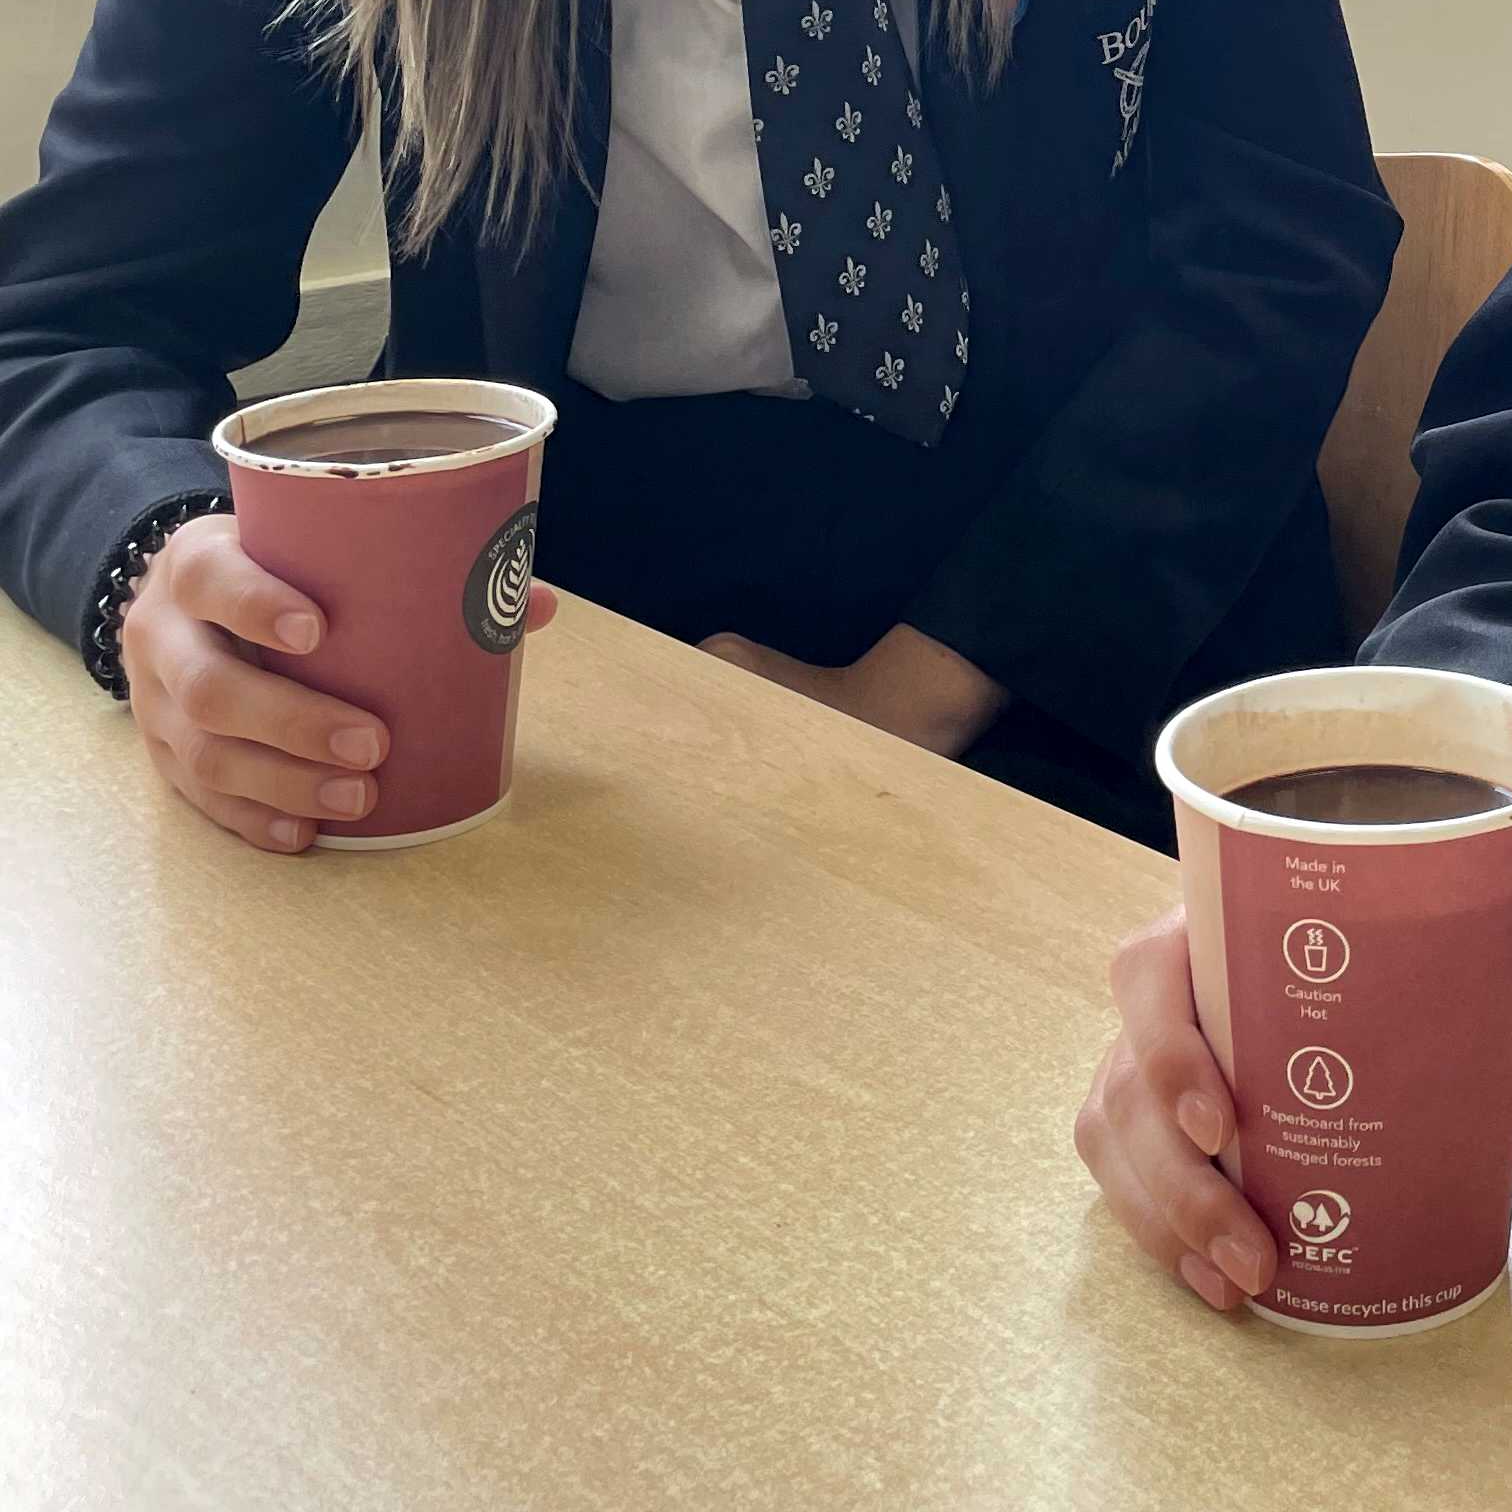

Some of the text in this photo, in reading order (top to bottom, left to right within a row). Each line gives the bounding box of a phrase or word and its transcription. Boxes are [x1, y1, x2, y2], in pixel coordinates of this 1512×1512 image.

[1285, 856, 1346, 874] Made in
[1290, 875, 1341, 892] the UK
[1285, 984, 1342, 1003] Caution
[1300, 1004, 1328, 1021] Hot
[1262, 1104, 1384, 1131] Paperboard from
[1282, 1131, 1361, 1152] sustainably
[1265, 1144, 1382, 1167] managed forests
[1289, 1242, 1353, 1264] PEFC
[1276, 1284, 1462, 1318] Please recycle this cup
